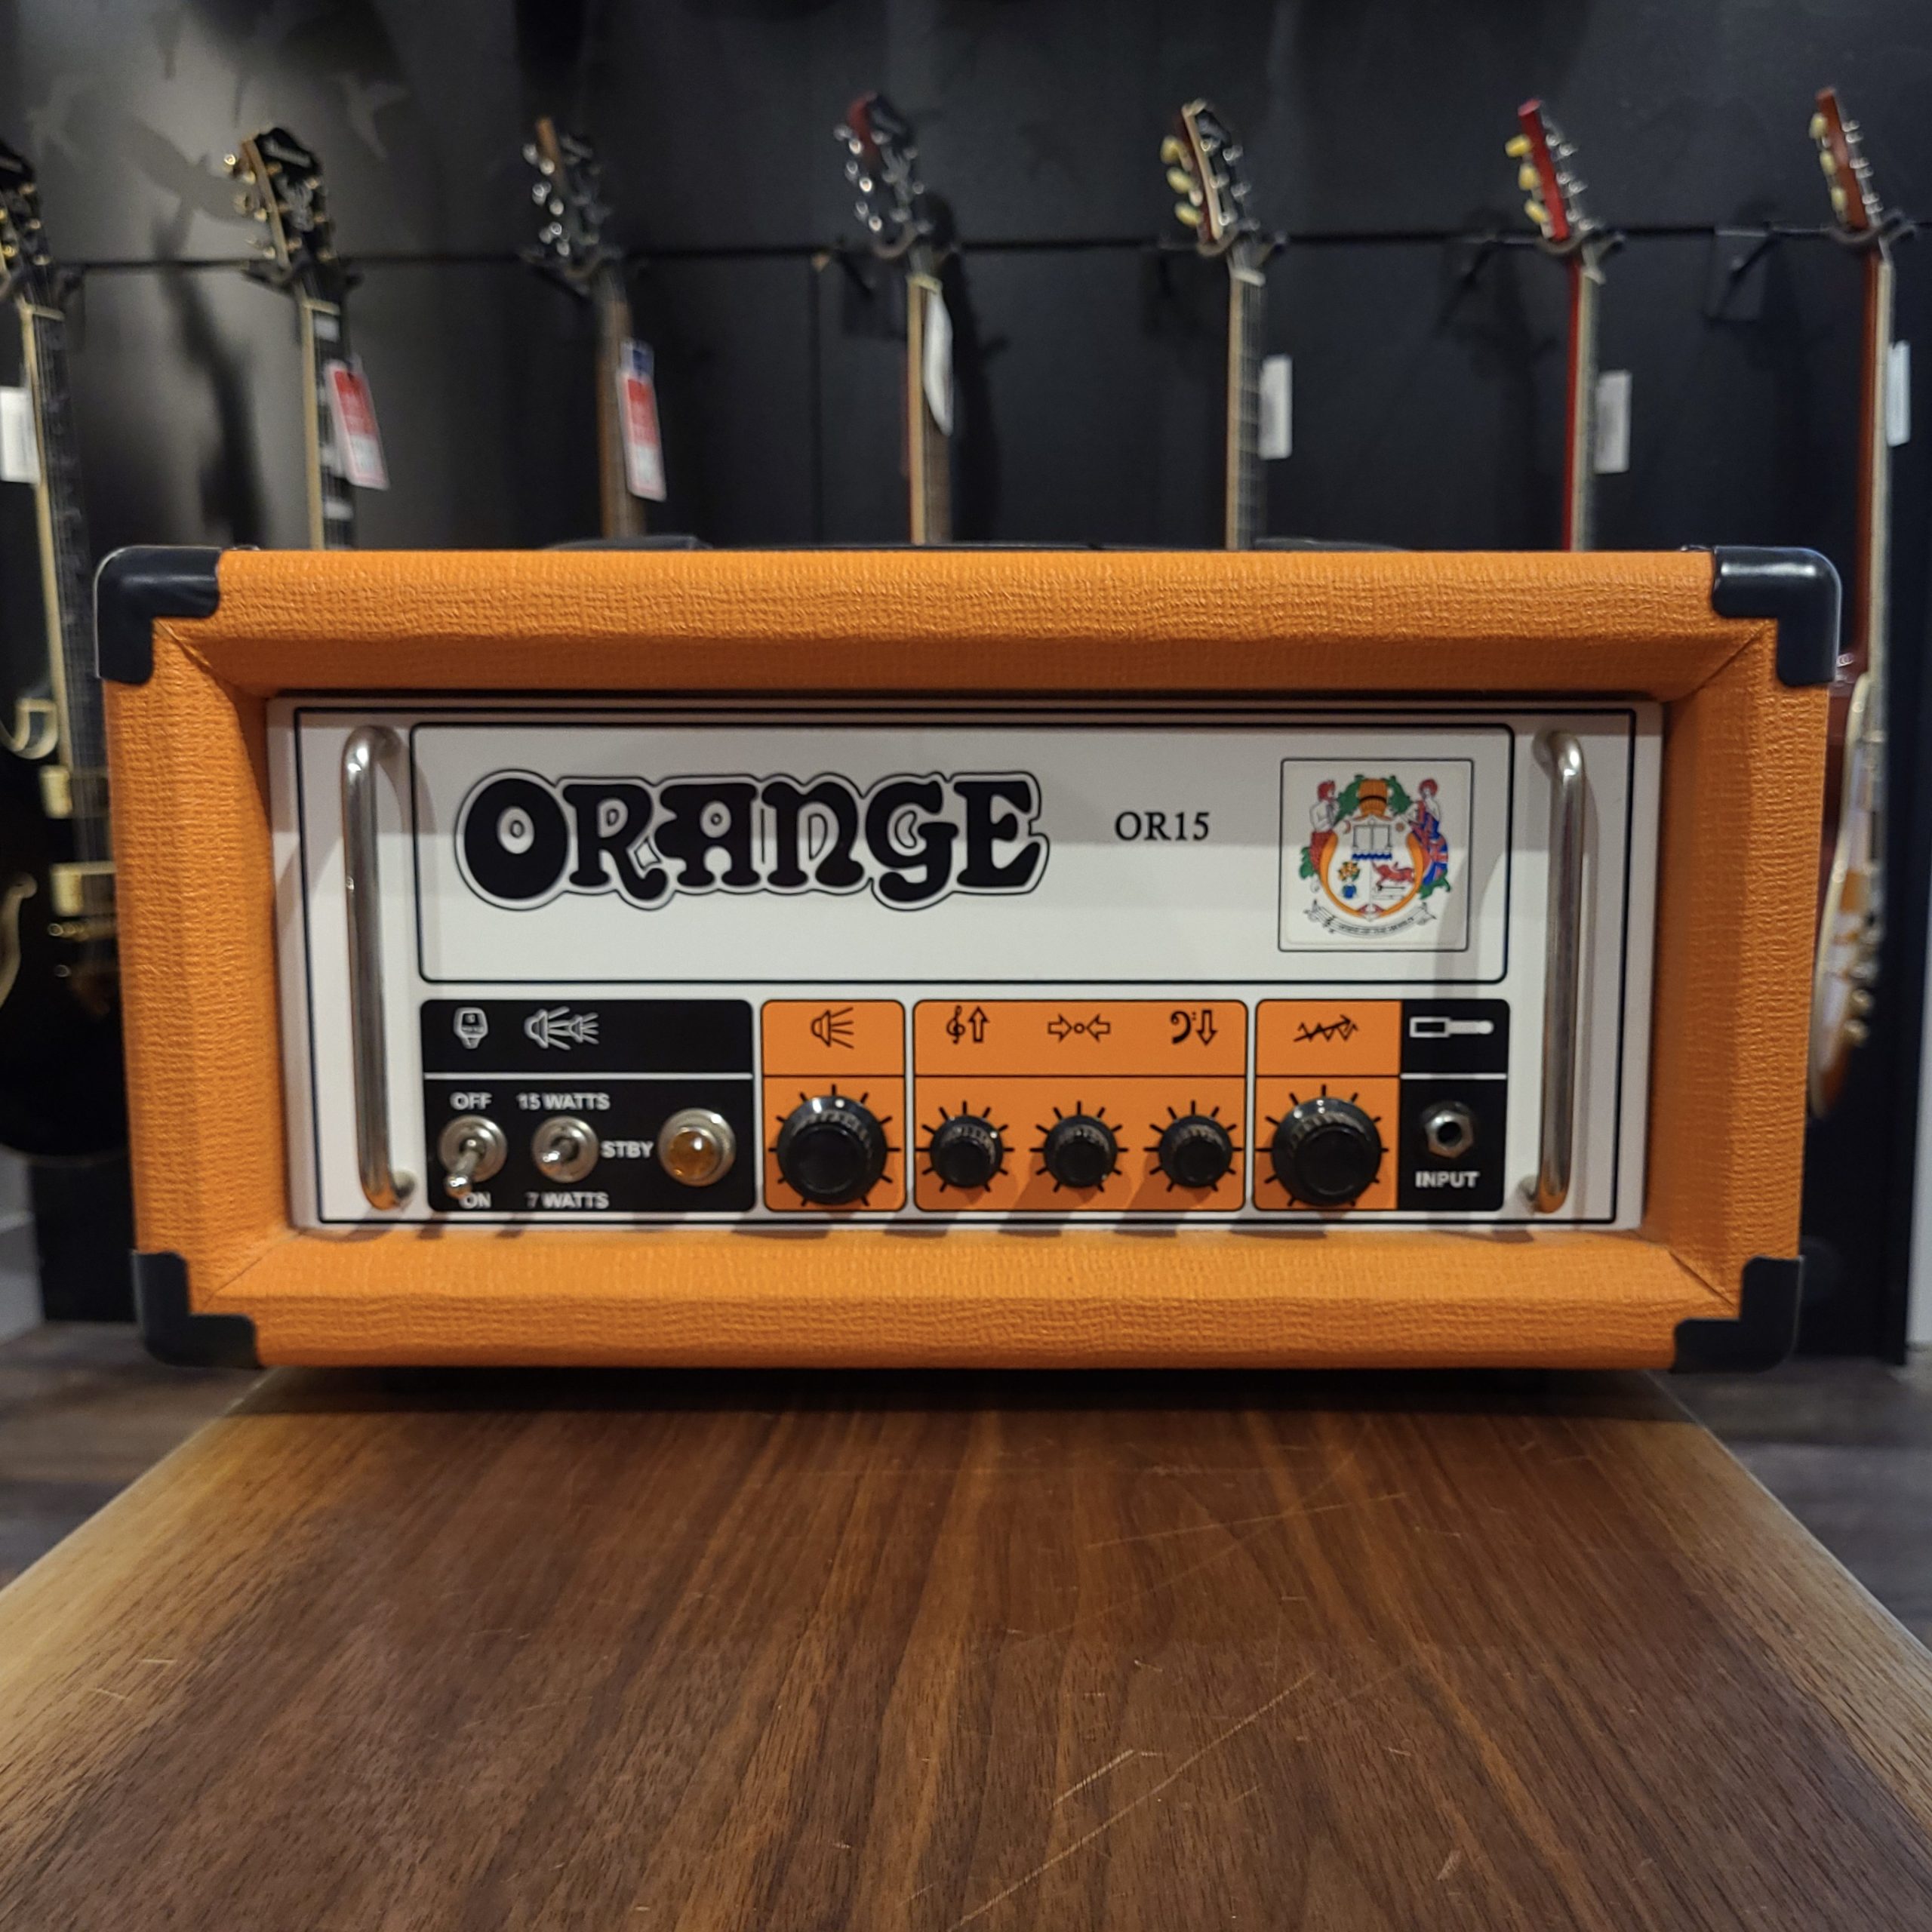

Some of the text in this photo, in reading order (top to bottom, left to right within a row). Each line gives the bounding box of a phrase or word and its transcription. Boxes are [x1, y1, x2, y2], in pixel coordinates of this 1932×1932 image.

[1115, 811, 1210, 841] OR15
[456, 769, 1051, 912] ORANGE
[450, 1093, 492, 1111] OFF
[516, 1094, 611, 1111] 15 WATTS
[600, 1140, 654, 1158] STBY
[1415, 1171, 1480, 1189] INPUT
[459, 1191, 491, 1209] ON
[526, 1192, 609, 1209] 7 WATTS
